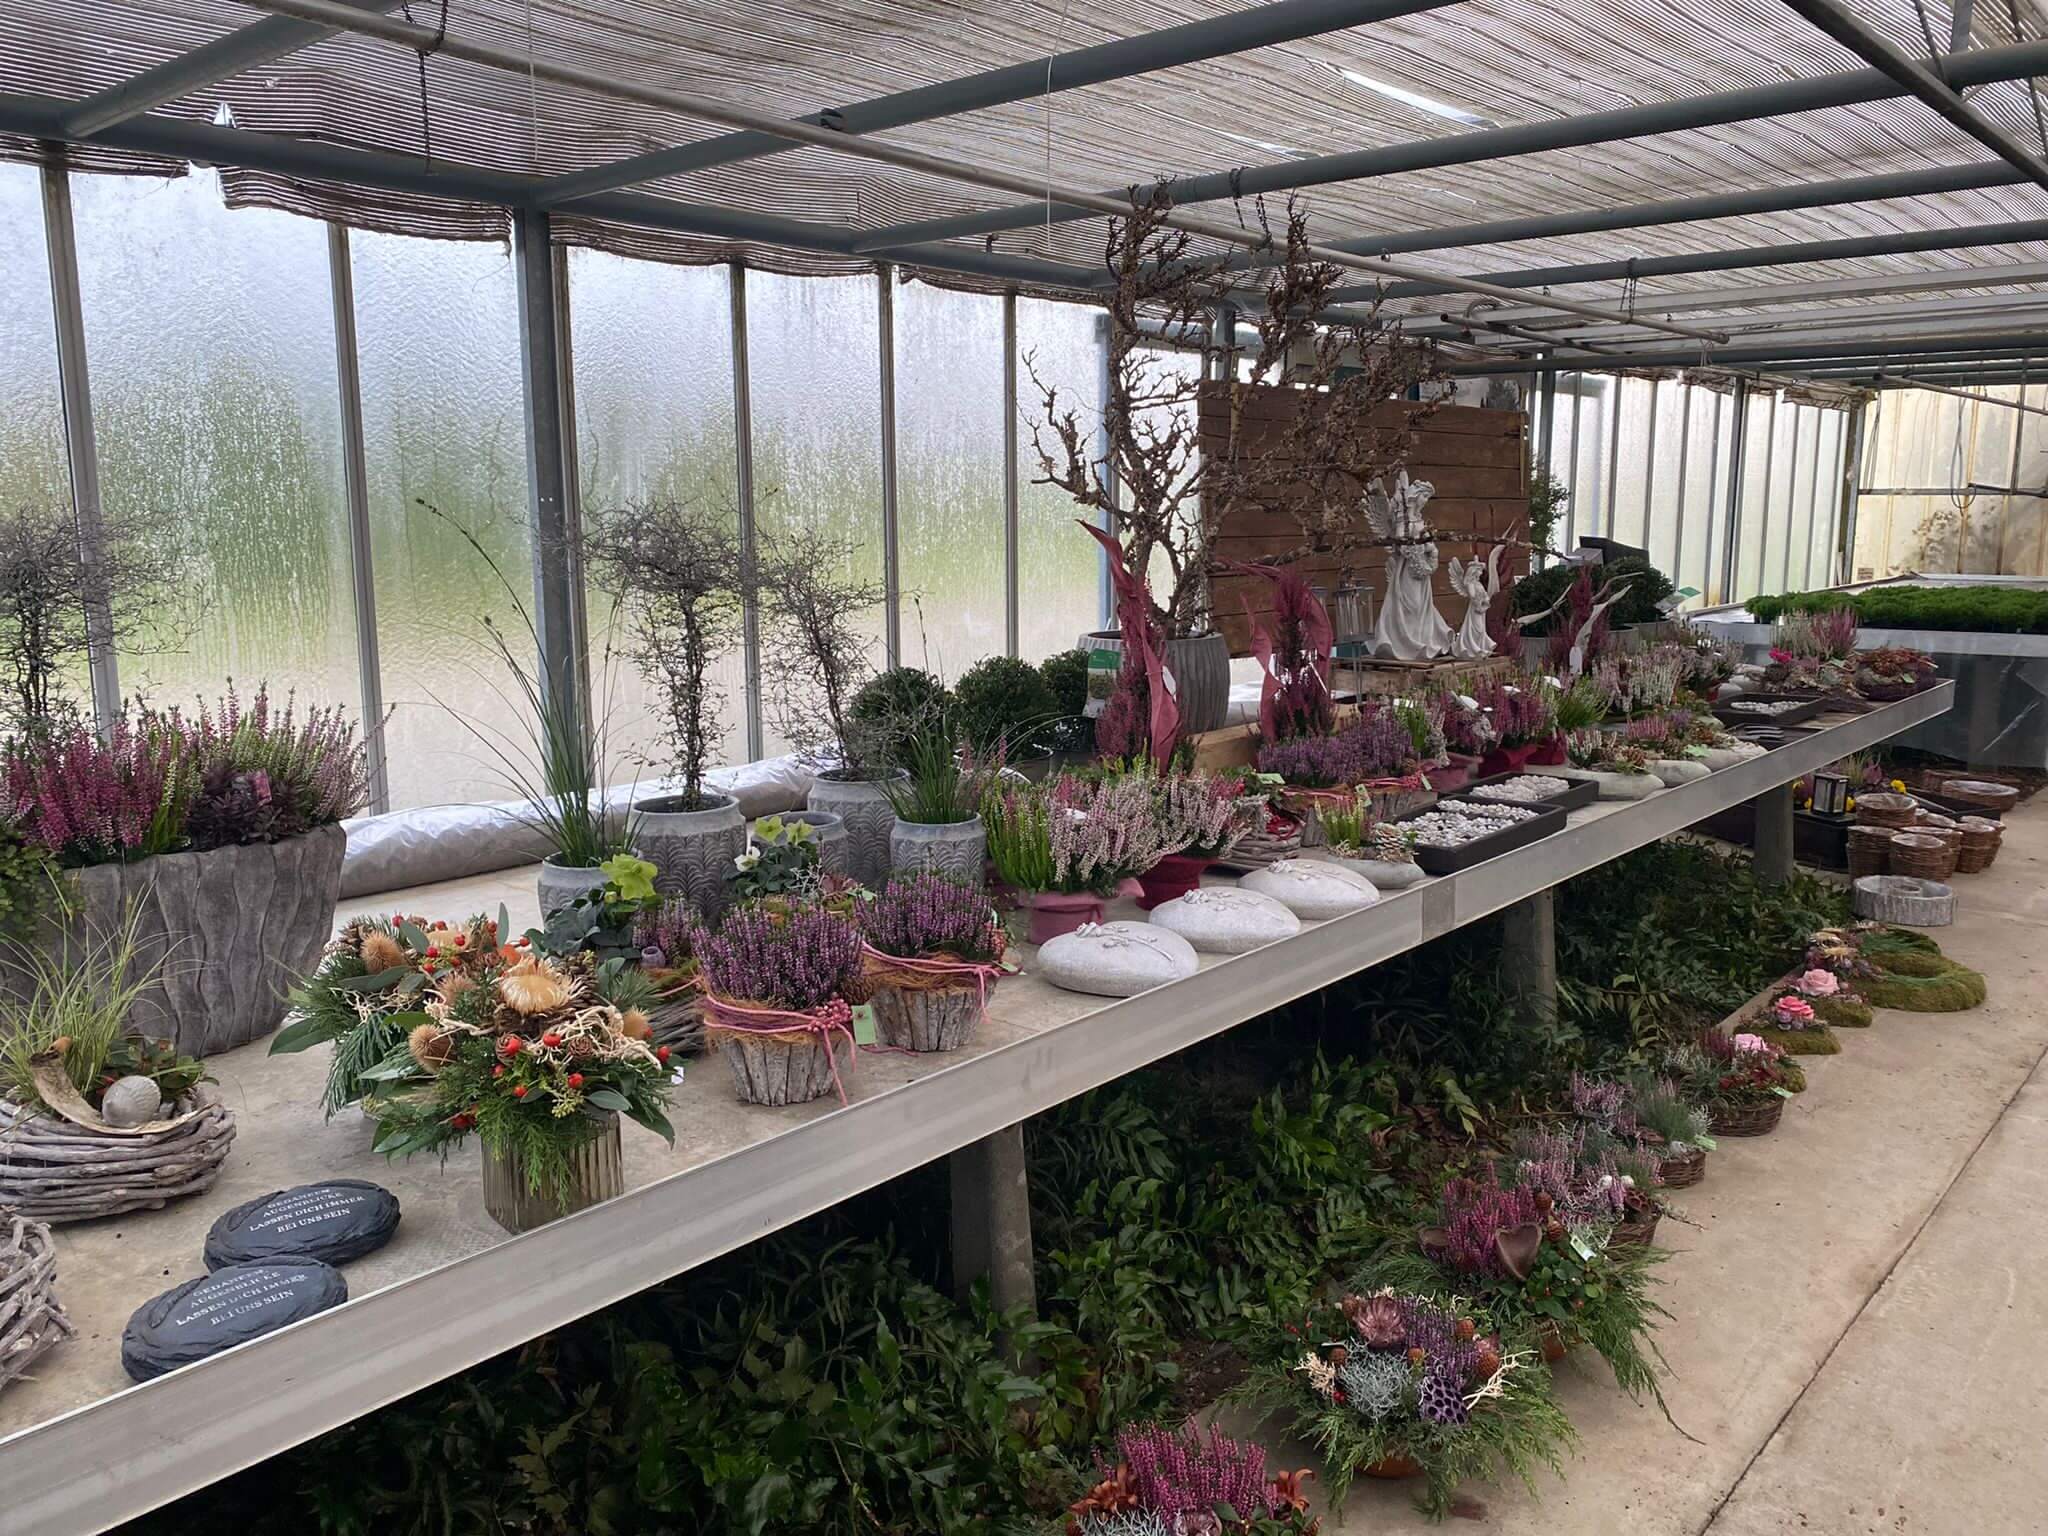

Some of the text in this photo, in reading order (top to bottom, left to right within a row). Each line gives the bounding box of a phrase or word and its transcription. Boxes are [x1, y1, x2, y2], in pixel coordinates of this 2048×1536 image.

[249, 1196, 365, 1231] LASSEN DICH IMMER
[263, 1192, 343, 1217] AUGENBLICKE
[277, 1208, 350, 1233] BEI UNS SEIN
[176, 1274, 308, 1326] LASSEN DICH IMMER
[210, 1289, 294, 1325] BEI UNS SEIN
